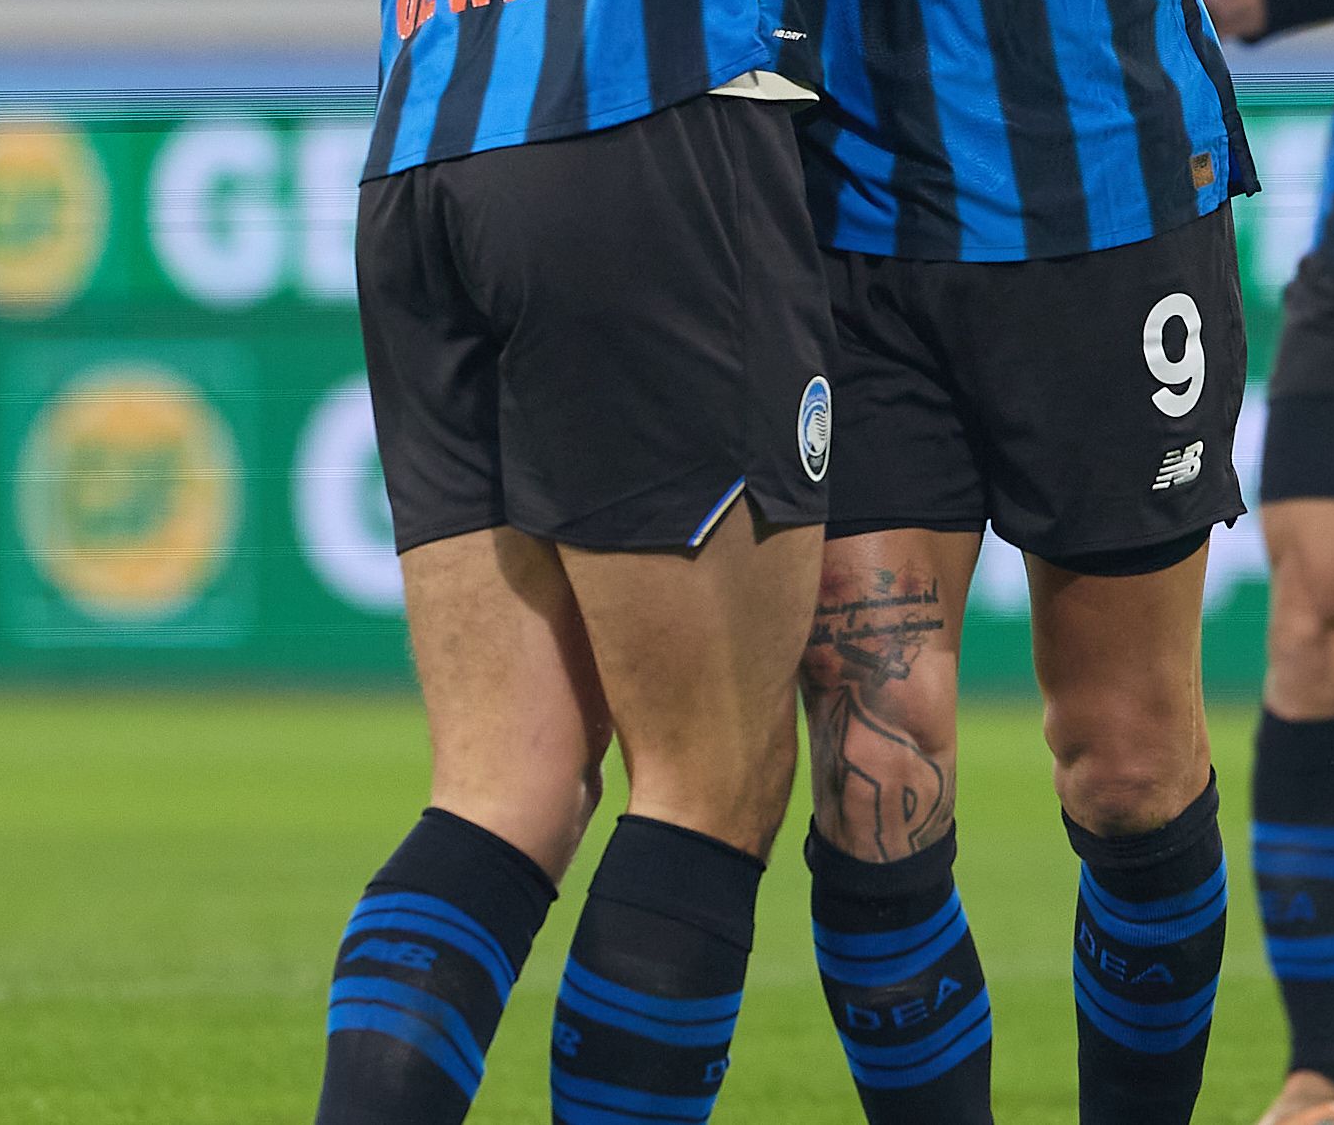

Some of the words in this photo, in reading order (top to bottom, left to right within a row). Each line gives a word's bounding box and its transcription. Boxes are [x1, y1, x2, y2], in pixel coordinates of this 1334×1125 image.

[1142, 292, 1206, 418] 9
[1078, 920, 1174, 982] DEA
[846, 976, 962, 1031] DEA
